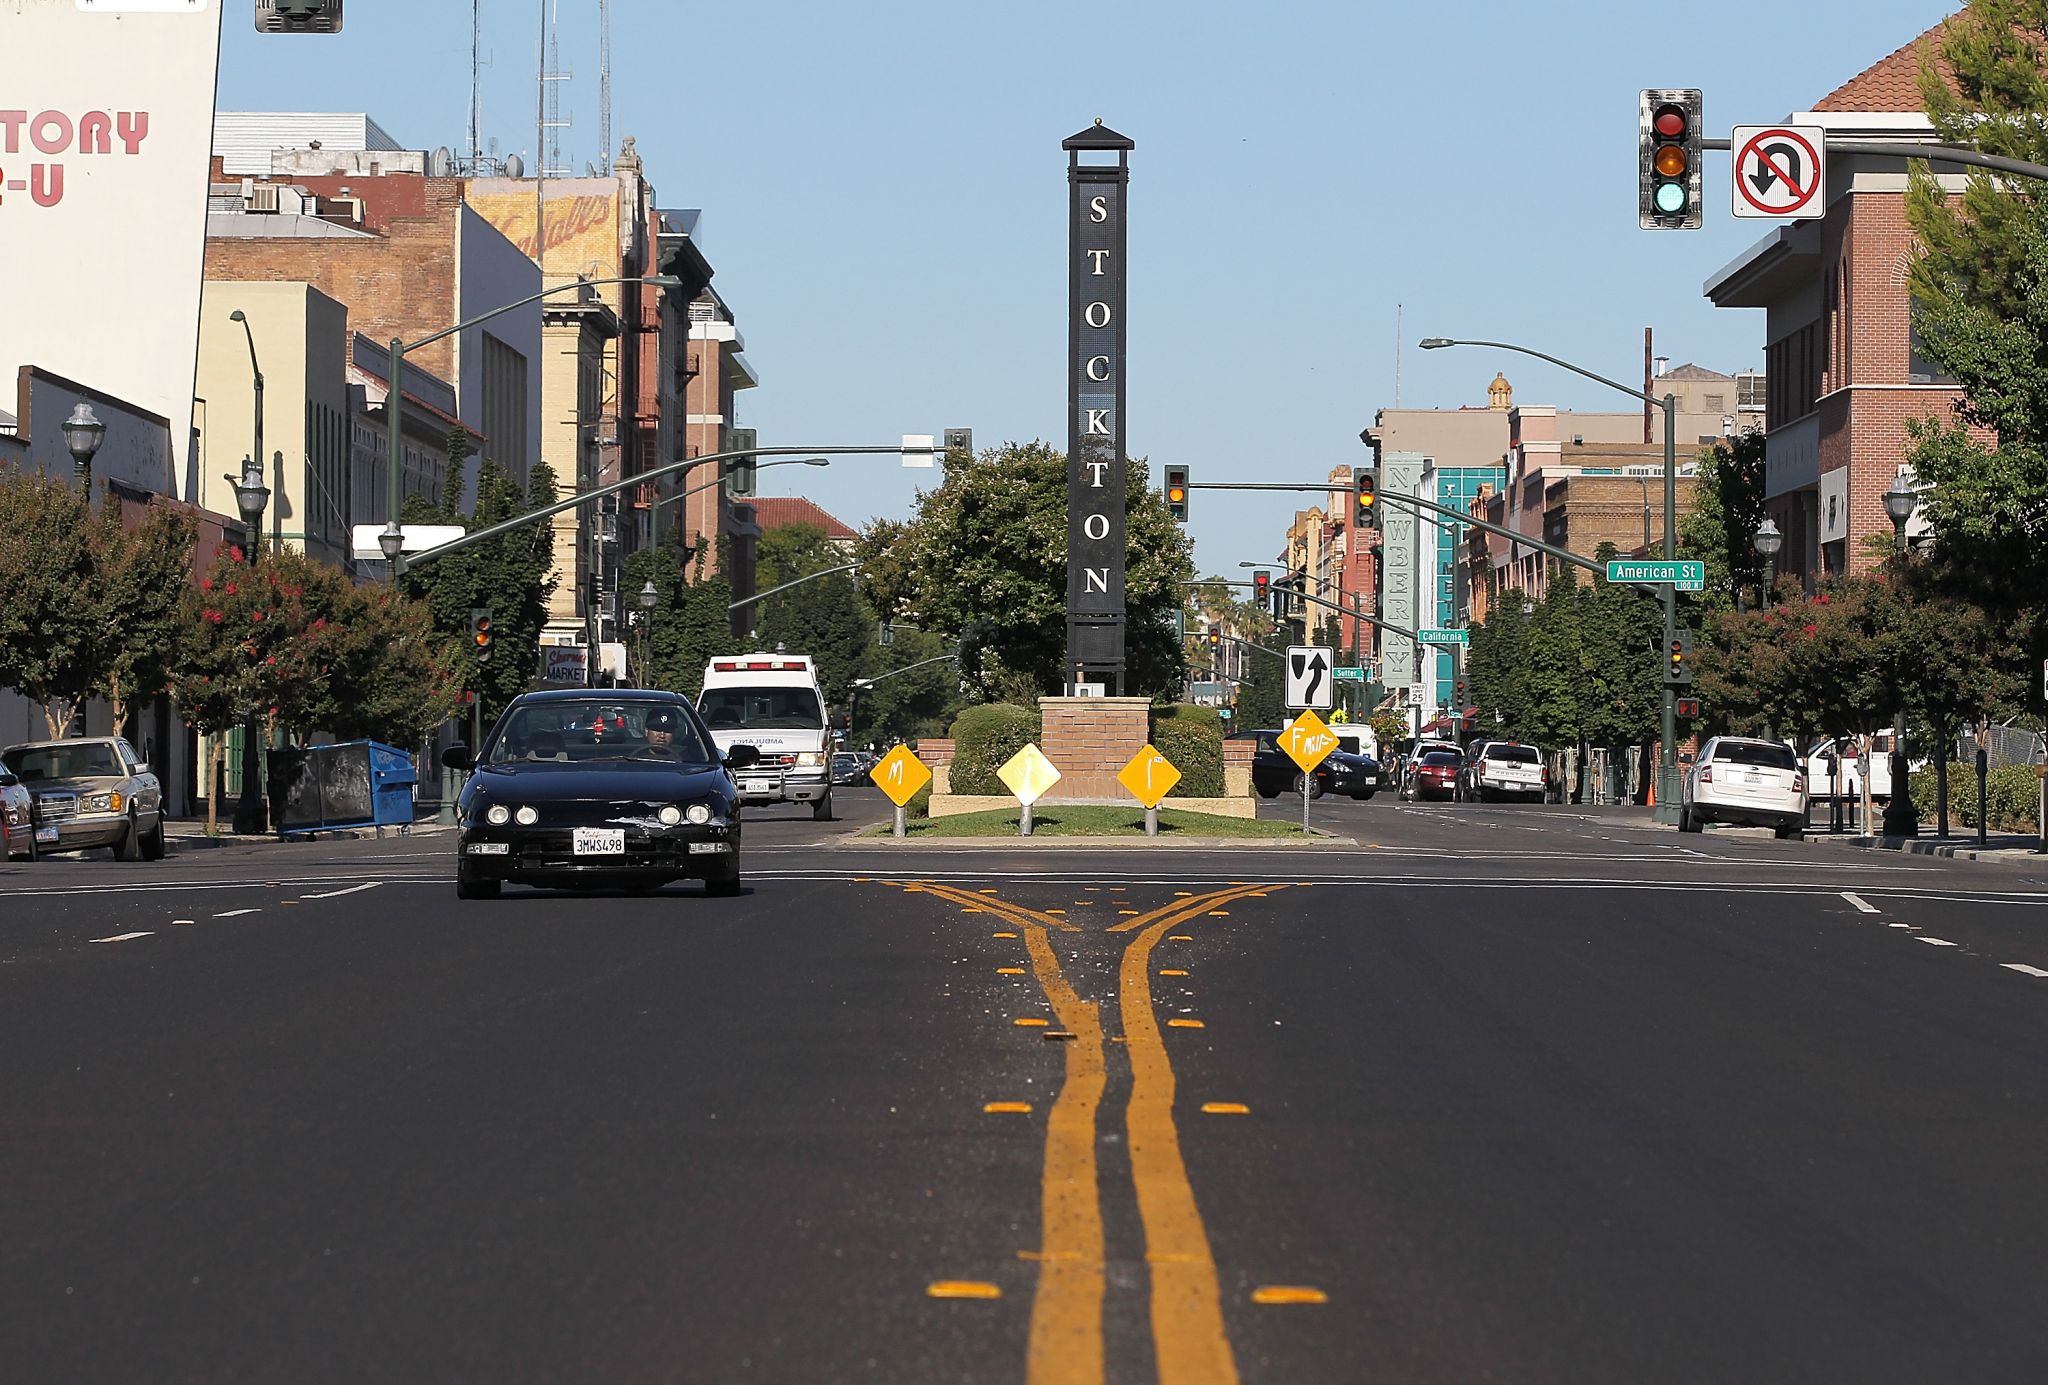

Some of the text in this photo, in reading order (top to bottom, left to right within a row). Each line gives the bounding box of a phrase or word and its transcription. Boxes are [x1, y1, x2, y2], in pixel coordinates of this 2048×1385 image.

[0, 163, 64, 207] -U
[1083, 195, 1112, 594] STOCKTON
[1616, 564, 1696, 579] American St
[1422, 631, 1463, 642] California
[547, 667, 587, 681] MARKET
[1412, 693, 1424, 703] 25
[576, 839, 622, 853] 3MWS498
